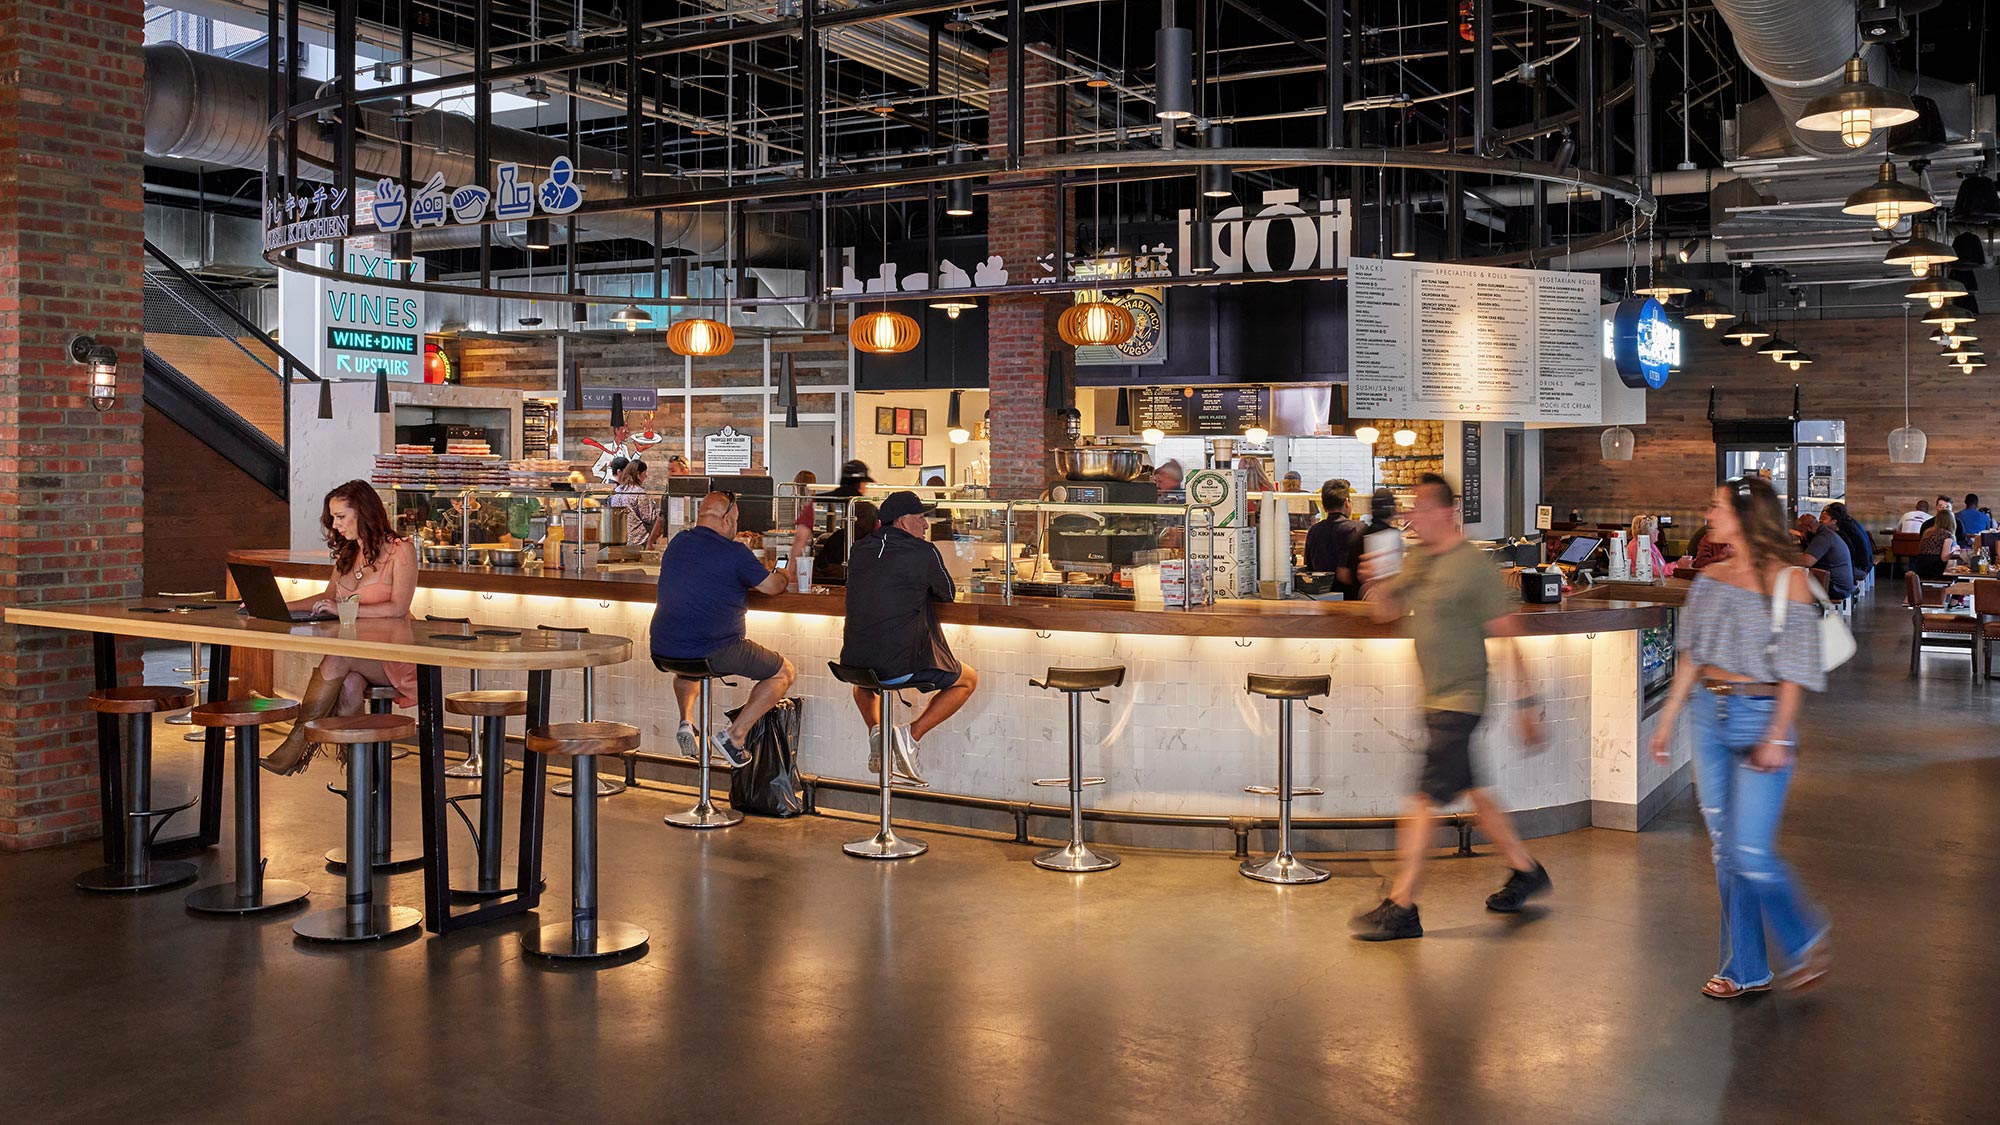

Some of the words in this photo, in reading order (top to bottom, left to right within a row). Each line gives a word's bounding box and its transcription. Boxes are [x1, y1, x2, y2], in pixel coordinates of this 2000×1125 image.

[288, 214, 350, 243] KITCHEN
[1436, 269, 1477, 277] SPECIALTIES
[328, 290, 418, 328] VINES
[333, 330, 414, 351] WINE+DINE
[1118, 342, 1154, 356] BURGER
[354, 356, 408, 376] UPSTAIRS
